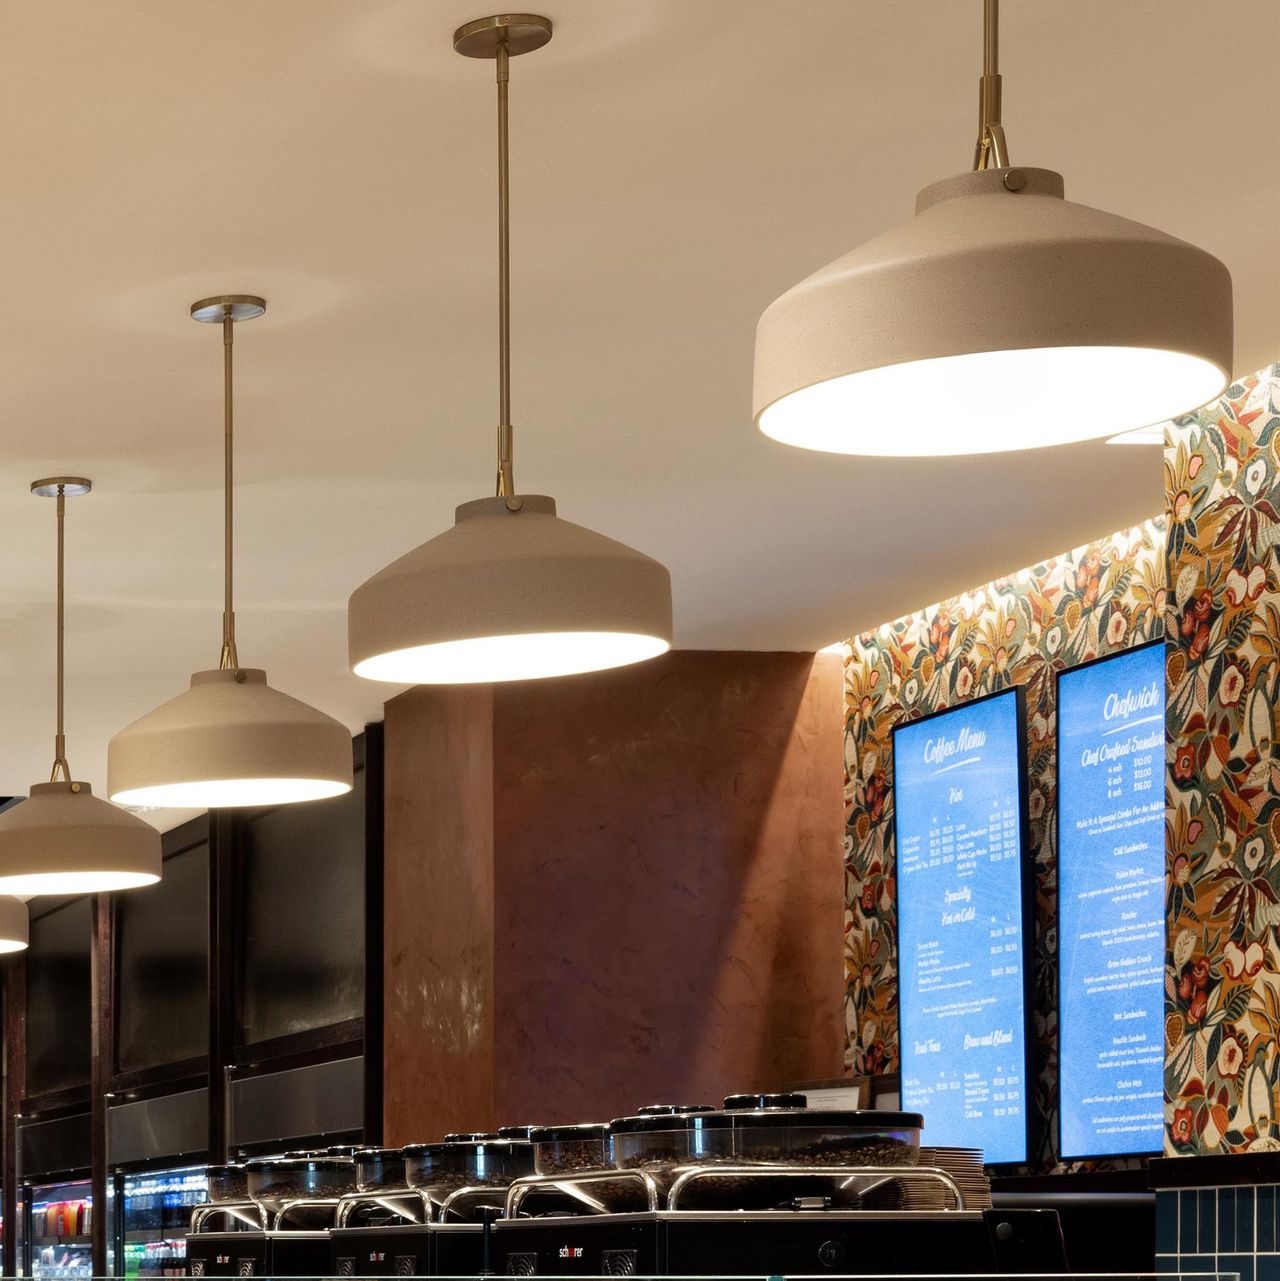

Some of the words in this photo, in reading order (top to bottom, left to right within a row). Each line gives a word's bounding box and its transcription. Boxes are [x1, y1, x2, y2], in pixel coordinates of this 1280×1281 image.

[1104, 681, 1160, 721] Chefwich
[924, 736, 956, 764] Coffee
[956, 727, 987, 752] Menu
[1081, 747, 1100, 767] Chef
[1099, 738, 1131, 762] Crafted
[1134, 754, 1153, 767] $10.00
[1134, 767, 1152, 779] $13.00
[949, 787, 964, 805] Hot
